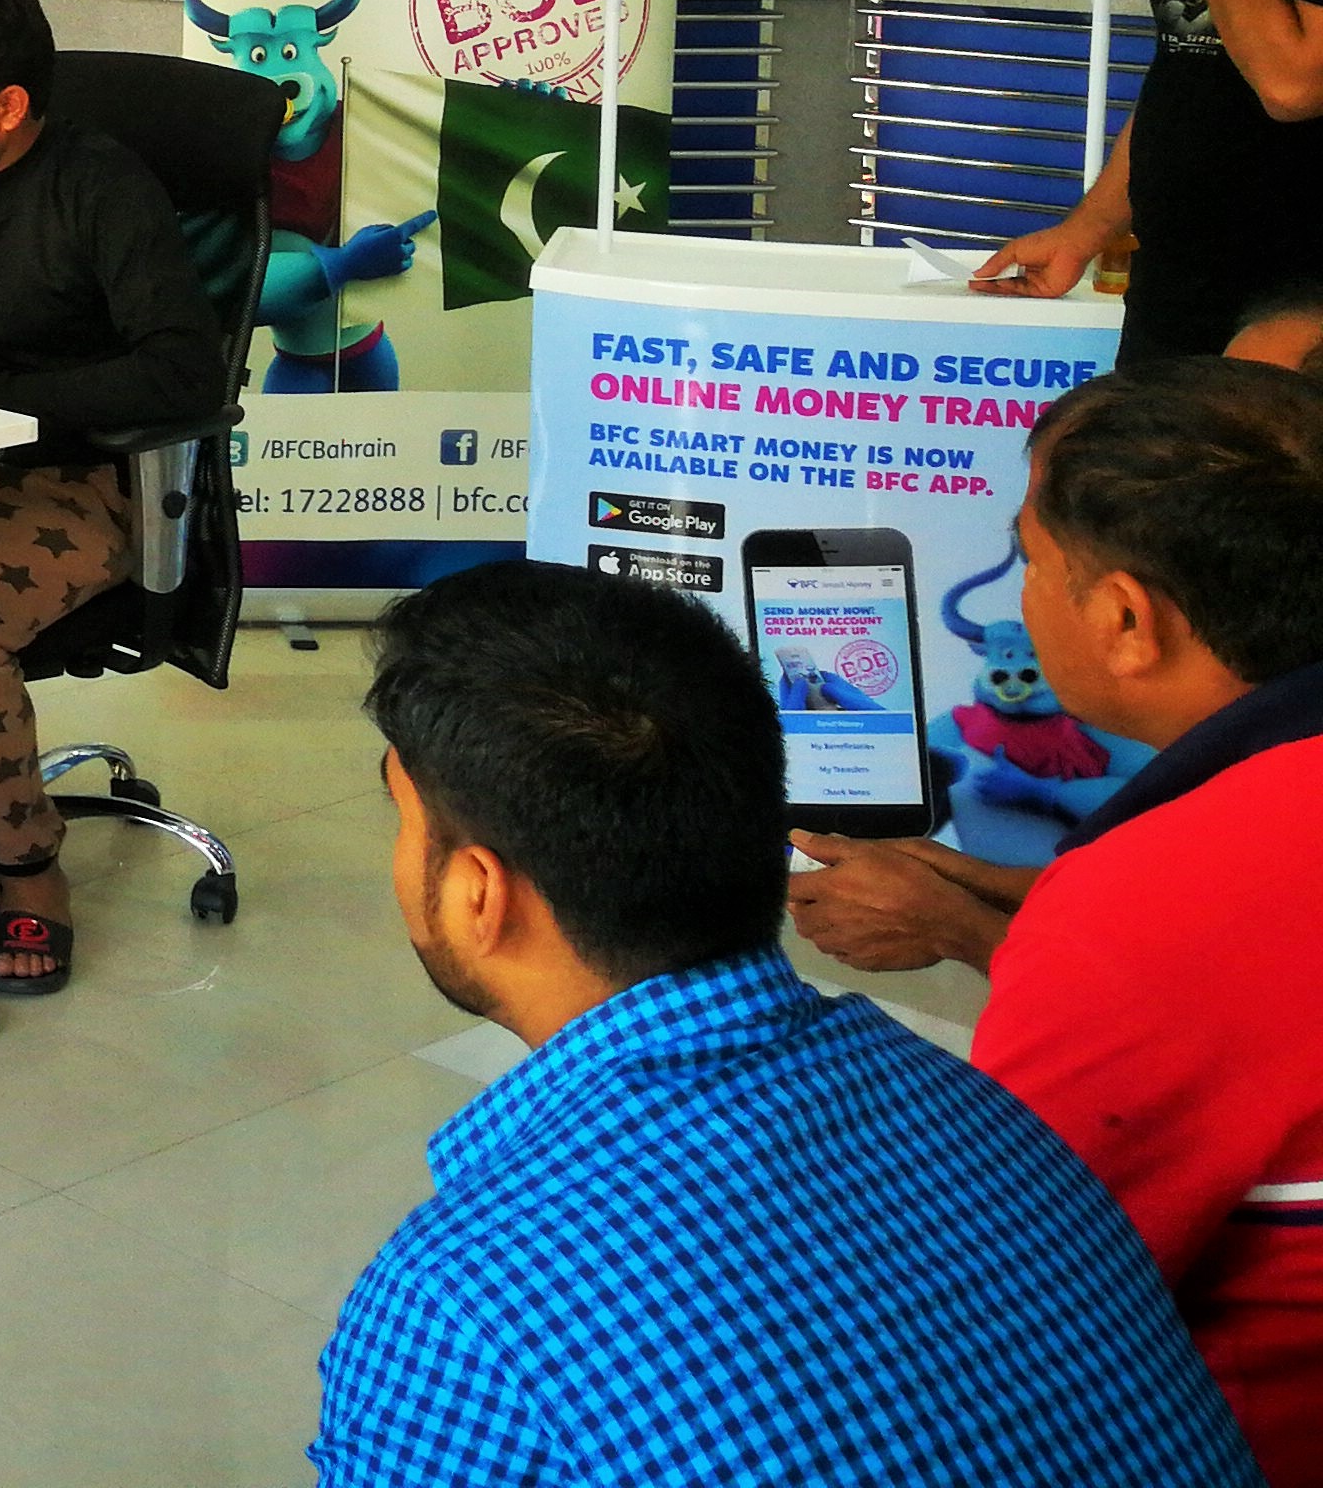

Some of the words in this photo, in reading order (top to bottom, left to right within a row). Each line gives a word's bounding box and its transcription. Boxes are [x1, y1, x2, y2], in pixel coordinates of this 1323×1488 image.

[591, 332, 697, 376] FAST,
[711, 341, 815, 377] SAFE
[828, 350, 921, 382] AND
[934, 354, 1097, 390] SECURE
[590, 371, 741, 412] ONLINE
[755, 382, 909, 423] MONEY
[261, 438, 397, 461] /BFCBahrain
[589, 423, 641, 447] BFC
[649, 427, 745, 454] SMART
[754, 436, 858, 464] MONEY
[866, 444, 895, 465] IS
[903, 447, 975, 470] NOW
[588, 447, 738, 479] AVAILABLE
[748, 460, 791, 484] ON
[801, 465, 856, 489] THE
[865, 470, 921, 495] BFC
[928, 473, 995, 497] APP.
[237, 487, 270, 513] el:
[281, 486, 426, 514] 17228888
[628, 499, 646, 509] GET
[628, 510, 684, 531] Google
[685, 515, 717, 535] Play
[628, 564, 664, 581] App
[665, 567, 713, 586] Store
[763, 607, 794, 616] SEND
[798, 607, 840, 616] MONEY
[764, 617, 805, 626] CREDIT
[809, 617, 824, 625] TO
[827, 616, 883, 625] ACCOUNT
[765, 627, 782, 636] OR
[785, 627, 817, 636] CASH
[820, 627, 849, 635] PICK
[851, 627, 871, 636] UP.
